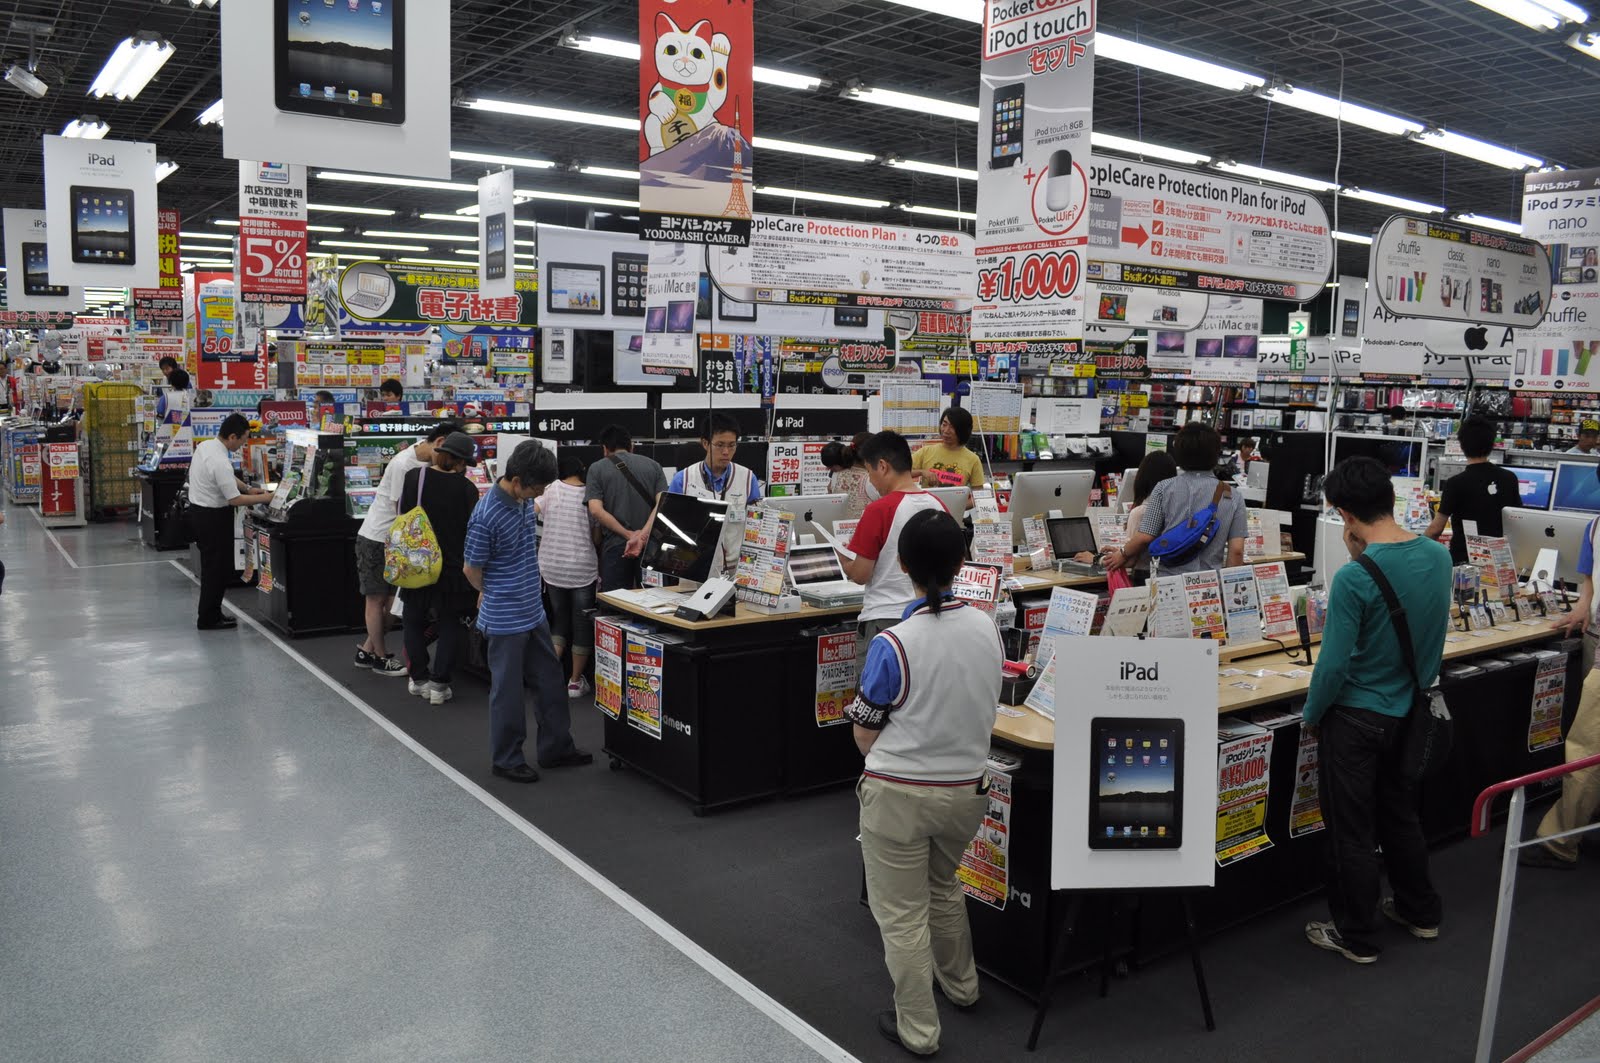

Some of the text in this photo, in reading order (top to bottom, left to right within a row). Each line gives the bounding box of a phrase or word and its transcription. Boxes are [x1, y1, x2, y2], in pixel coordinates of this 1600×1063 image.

[990, 6, 1087, 52] iPod touch
[1029, 35, 1086, 75] セット
[678, 94, 692, 107] 福
[1035, 120, 1083, 137] iPod touch 8GB
[88, 152, 115, 166] iPad
[244, 184, 303, 198] 本店欢迎使用
[1090, 163, 1306, 216] ppleCare Protection Plan for iPod
[1526, 181, 1580, 192] ヨドバシカメラ
[249, 196, 298, 208] 中国银联卡
[1528, 198, 1558, 210] iPod
[34, 219, 47, 228] iPa
[1039, 210, 1074, 223] Pocket WiFi
[1549, 217, 1587, 230] nano
[661, 216, 732, 233] ヨドバシカメラ
[644, 229, 745, 244] YODOBASHI CAMERA
[751, 217, 959, 247] ppleCare Protection Plan 4つの安心
[1397, 240, 1421, 255] shuffle
[246, 237, 302, 277] 5%
[1448, 248, 1465, 262] classic
[1487, 257, 1500, 269] nano
[1523, 263, 1538, 274] touch
[161, 278, 179, 287] FREE
[978, 252, 1079, 302] ¥1,000
[515, 280, 538, 291] ありま
[664, 280, 684, 294] iMac
[685, 282, 696, 293] 登場
[419, 289, 520, 321] 電子辞書
[1373, 306, 1418, 323] App
[1543, 307, 1587, 322] huffle
[1218, 320, 1242, 330] iMac
[1244, 322, 1258, 331] 登場
[1364, 338, 1424, 347] Yodobashi-Camera
[840, 344, 895, 362] 大判プリンター
[1259, 351, 1329, 364] アクセリー
[1334, 349, 1361, 363] iPa
[706, 360, 715, 393] おトク
[716, 360, 724, 391] もっと
[725, 360, 733, 393] お買い
[265, 410, 303, 422] Canon
[785, 416, 804, 428] iPad
[193, 424, 220, 436] Wi-F
[550, 418, 574, 432] iPad
[674, 417, 695, 430] iPad
[774, 446, 798, 457] iPad
[772, 459, 800, 470] ご予約
[772, 472, 799, 483] 受付中
[51, 480, 63, 511] ーナー
[1185, 575, 1200, 586] iPod
[1120, 661, 1158, 681] iPad
[663, 714, 691, 736] amera
[1226, 744, 1266, 764] iPodシリーズ
[998, 784, 1009, 795] Set
